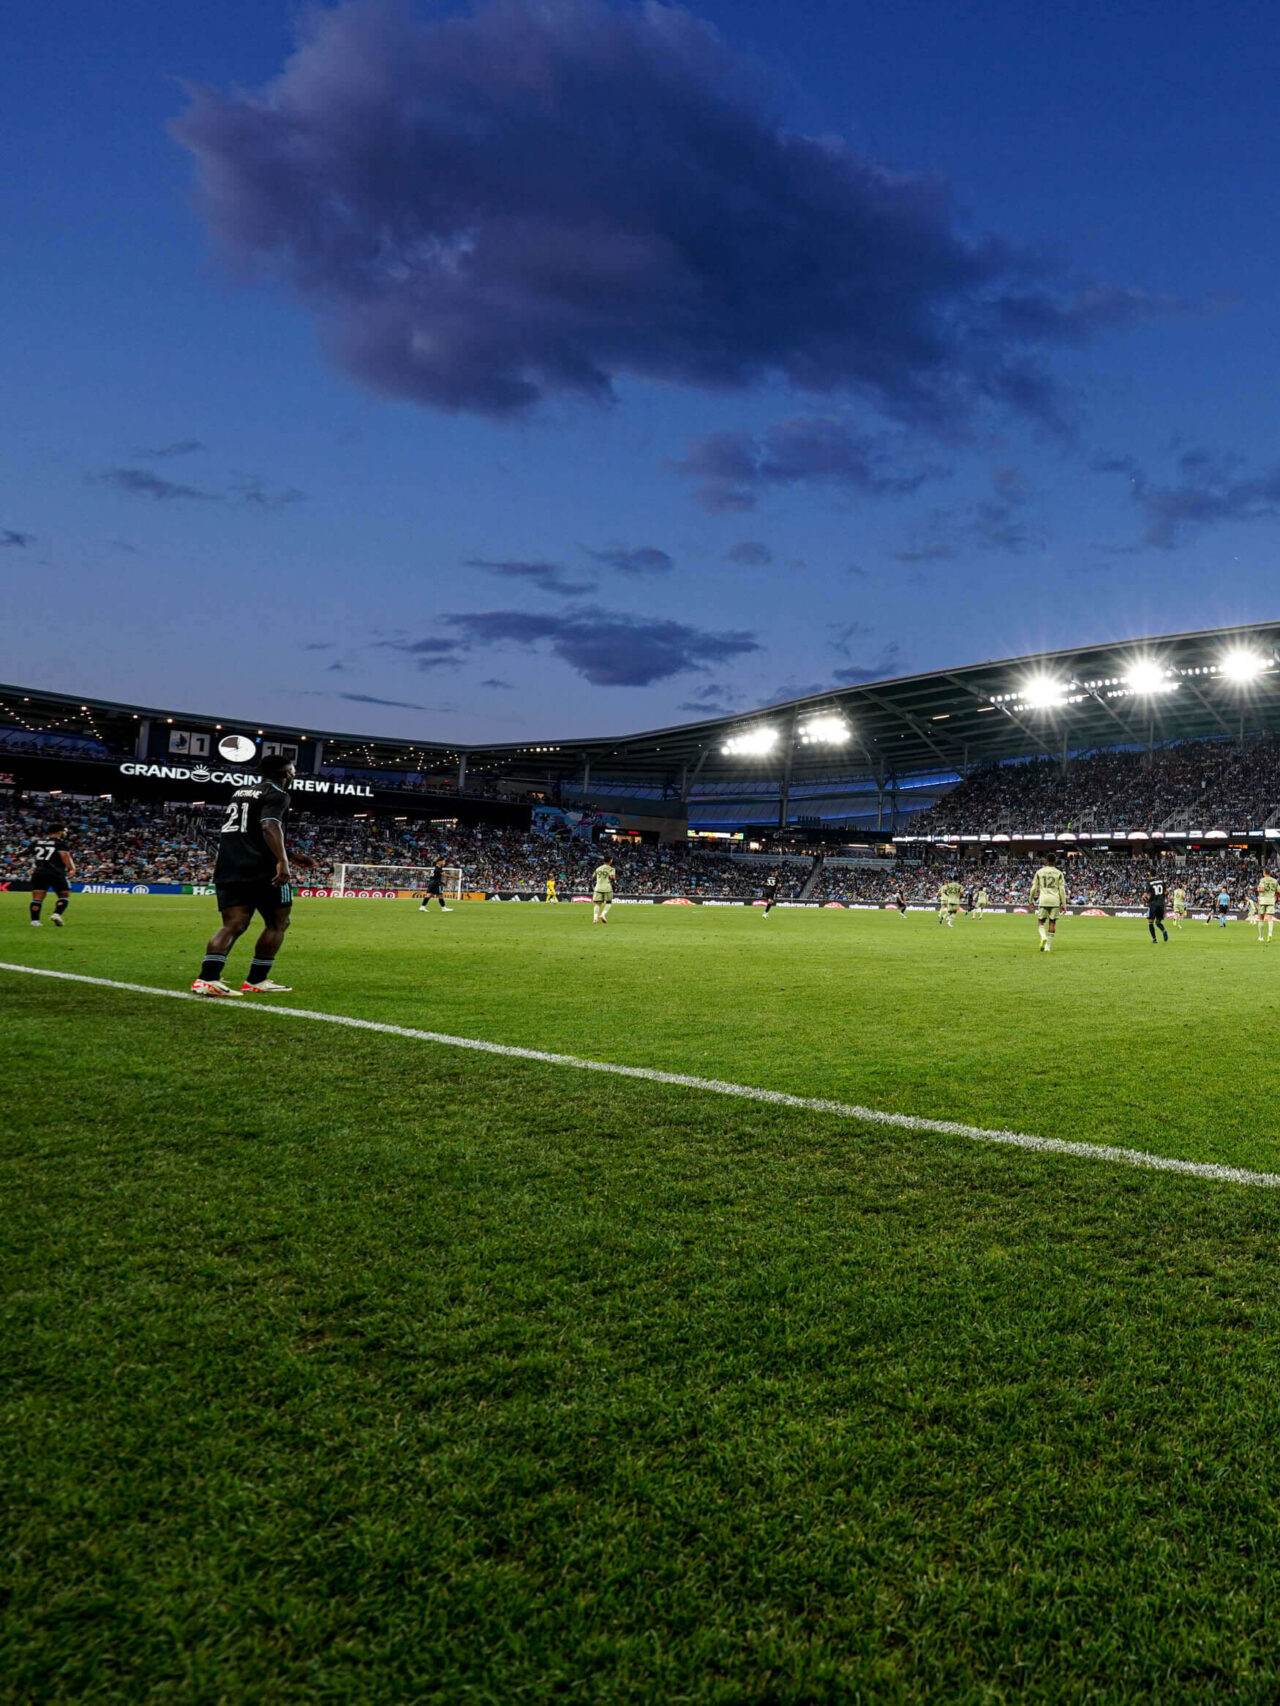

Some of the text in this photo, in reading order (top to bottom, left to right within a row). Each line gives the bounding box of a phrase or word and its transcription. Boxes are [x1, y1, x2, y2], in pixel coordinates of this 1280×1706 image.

[119, 763, 190, 780] GRAND
[210, 771, 263, 787] CASIN
[333, 783, 375, 798] HALL
[221, 802, 250, 833] 21
[34, 846, 56, 861] 27
[81, 885, 130, 895] Allianz
[1041, 876, 1056, 889] 12
[1152, 884, 1164, 896] 10
